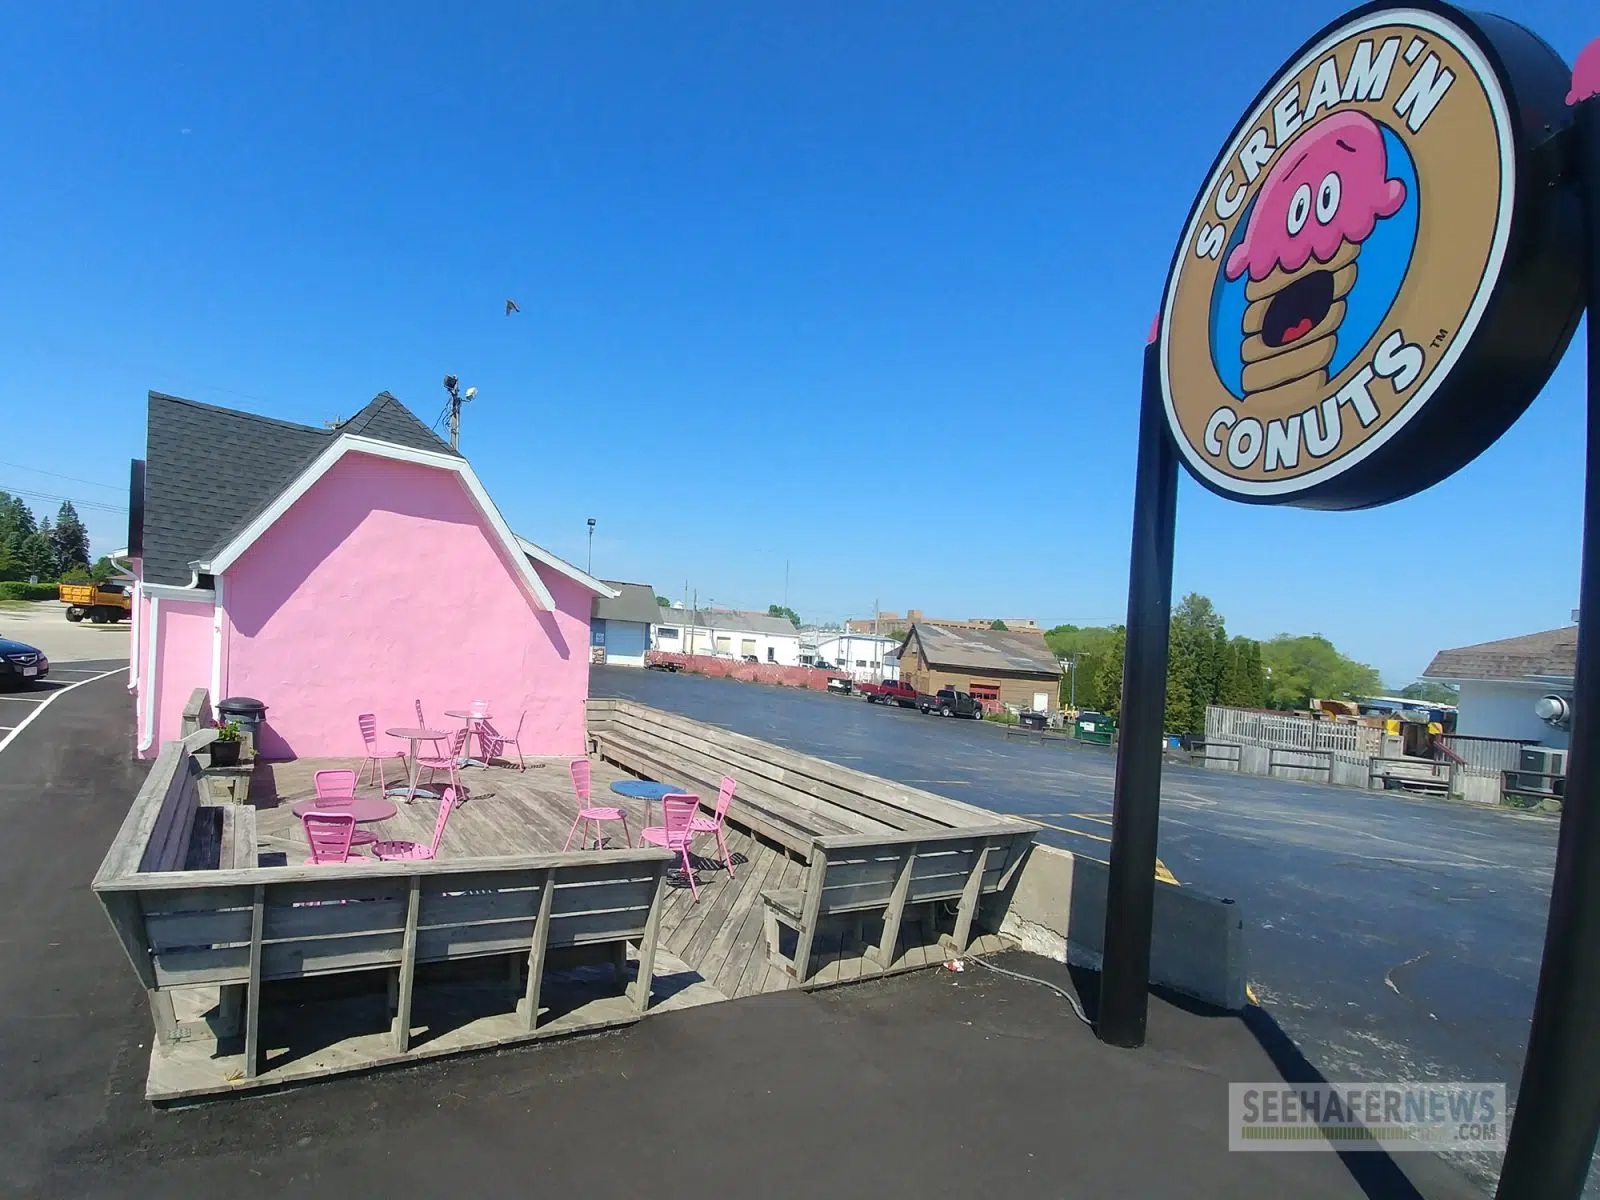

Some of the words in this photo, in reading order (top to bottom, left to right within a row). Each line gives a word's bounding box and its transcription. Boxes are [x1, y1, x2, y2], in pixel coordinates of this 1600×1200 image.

[1196, 36, 1455, 260] SCREAM'N
[1204, 329, 1425, 472] CONUTS
[1430, 328, 1448, 348] TM
